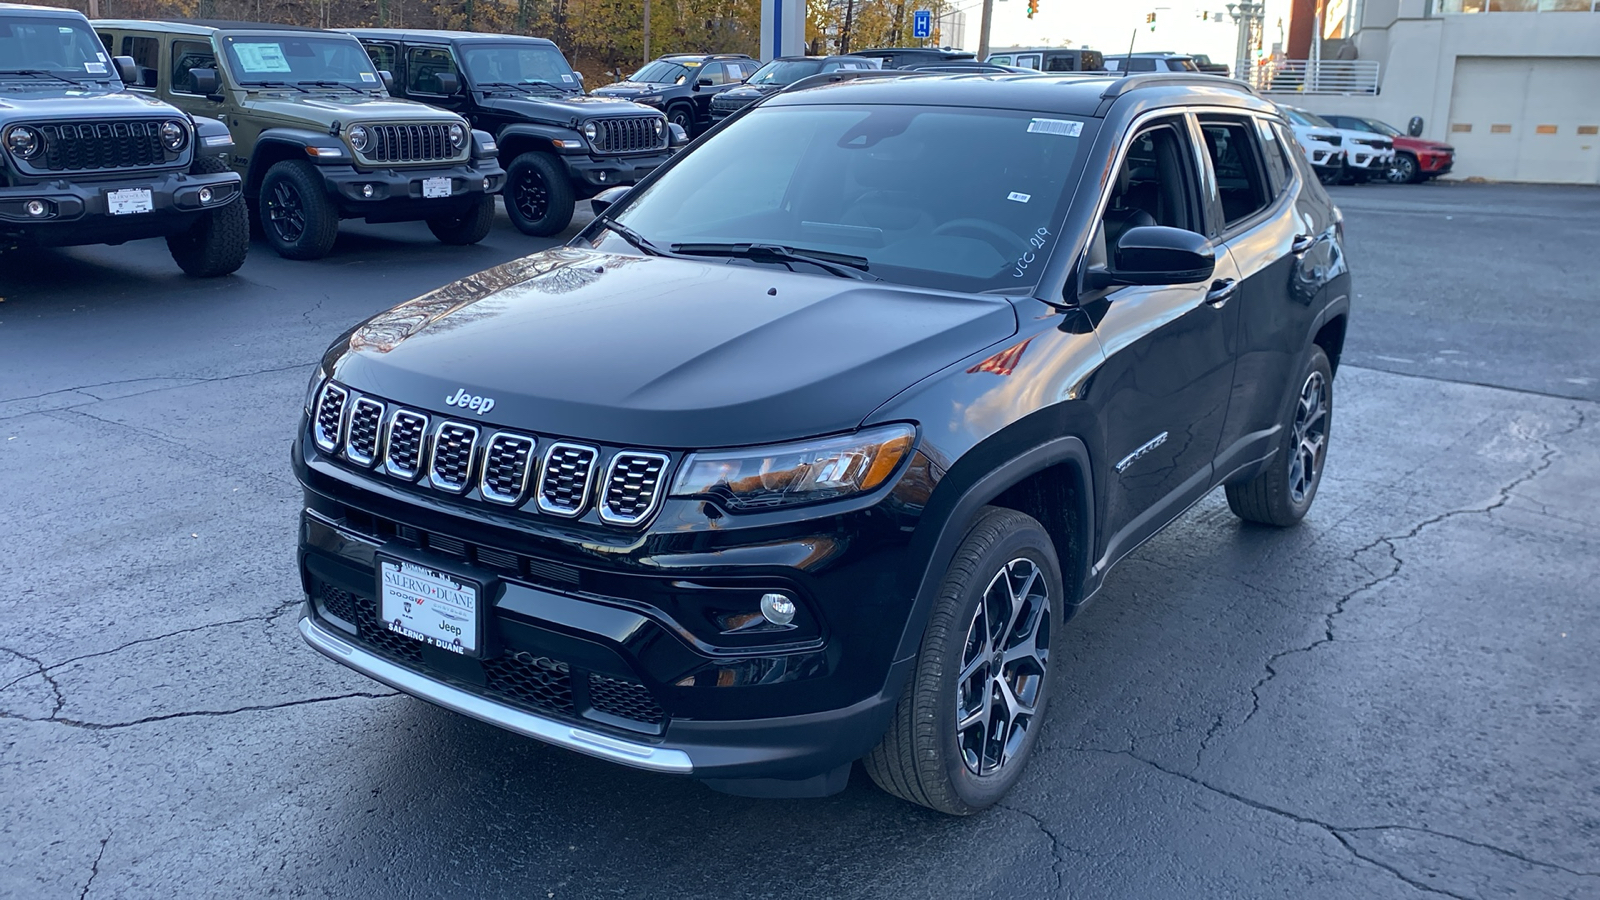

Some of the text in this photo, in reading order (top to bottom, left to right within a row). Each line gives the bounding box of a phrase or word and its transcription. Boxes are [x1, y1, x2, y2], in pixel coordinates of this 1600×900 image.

[917, 16, 927, 30] H
[1030, 227, 1052, 249] 219
[445, 388, 495, 415] Jeep
[384, 571, 474, 609] SALERNO DUANE
[388, 623, 464, 655] SALERNO DUANE
[439, 620, 461, 636] Jeep
